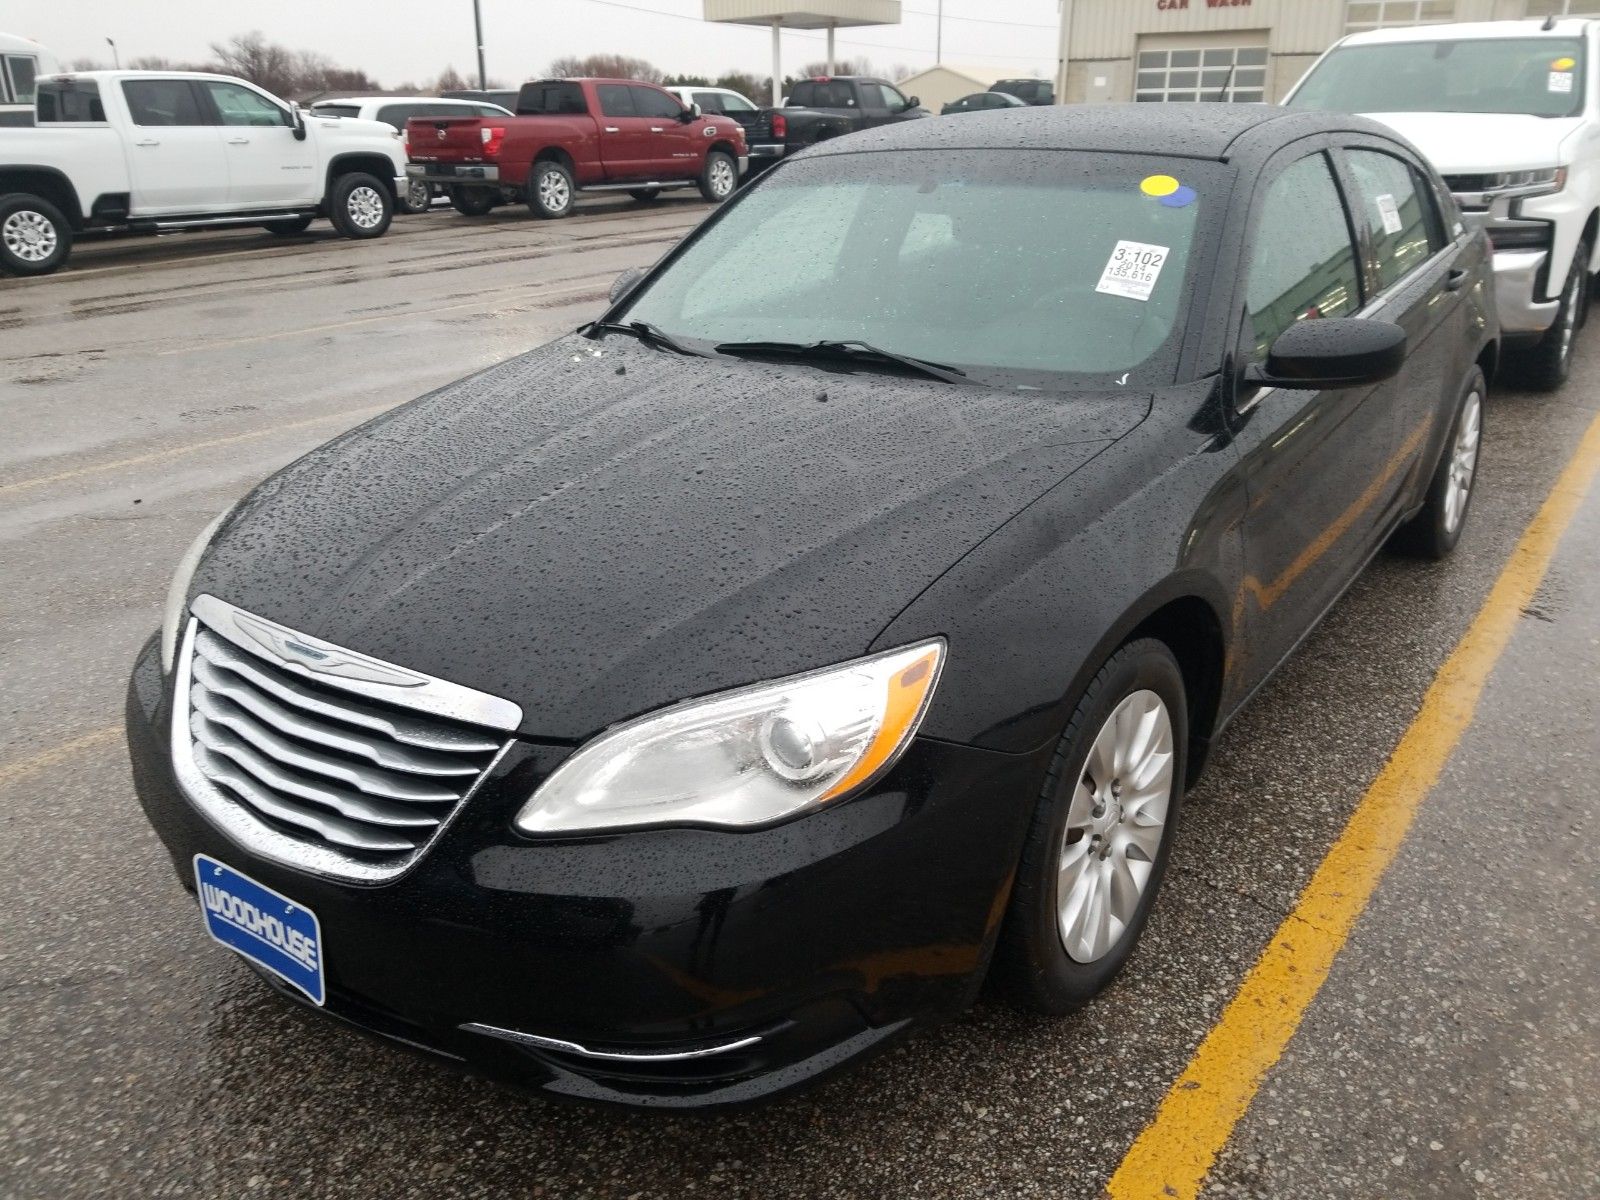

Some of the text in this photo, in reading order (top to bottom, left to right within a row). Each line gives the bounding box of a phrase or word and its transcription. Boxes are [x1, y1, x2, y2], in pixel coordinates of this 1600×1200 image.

[1157, 0, 1252, 10] CAR WASH
[1119, 261, 1147, 272] 2014
[202, 882, 318, 970] WOODHOUSE
